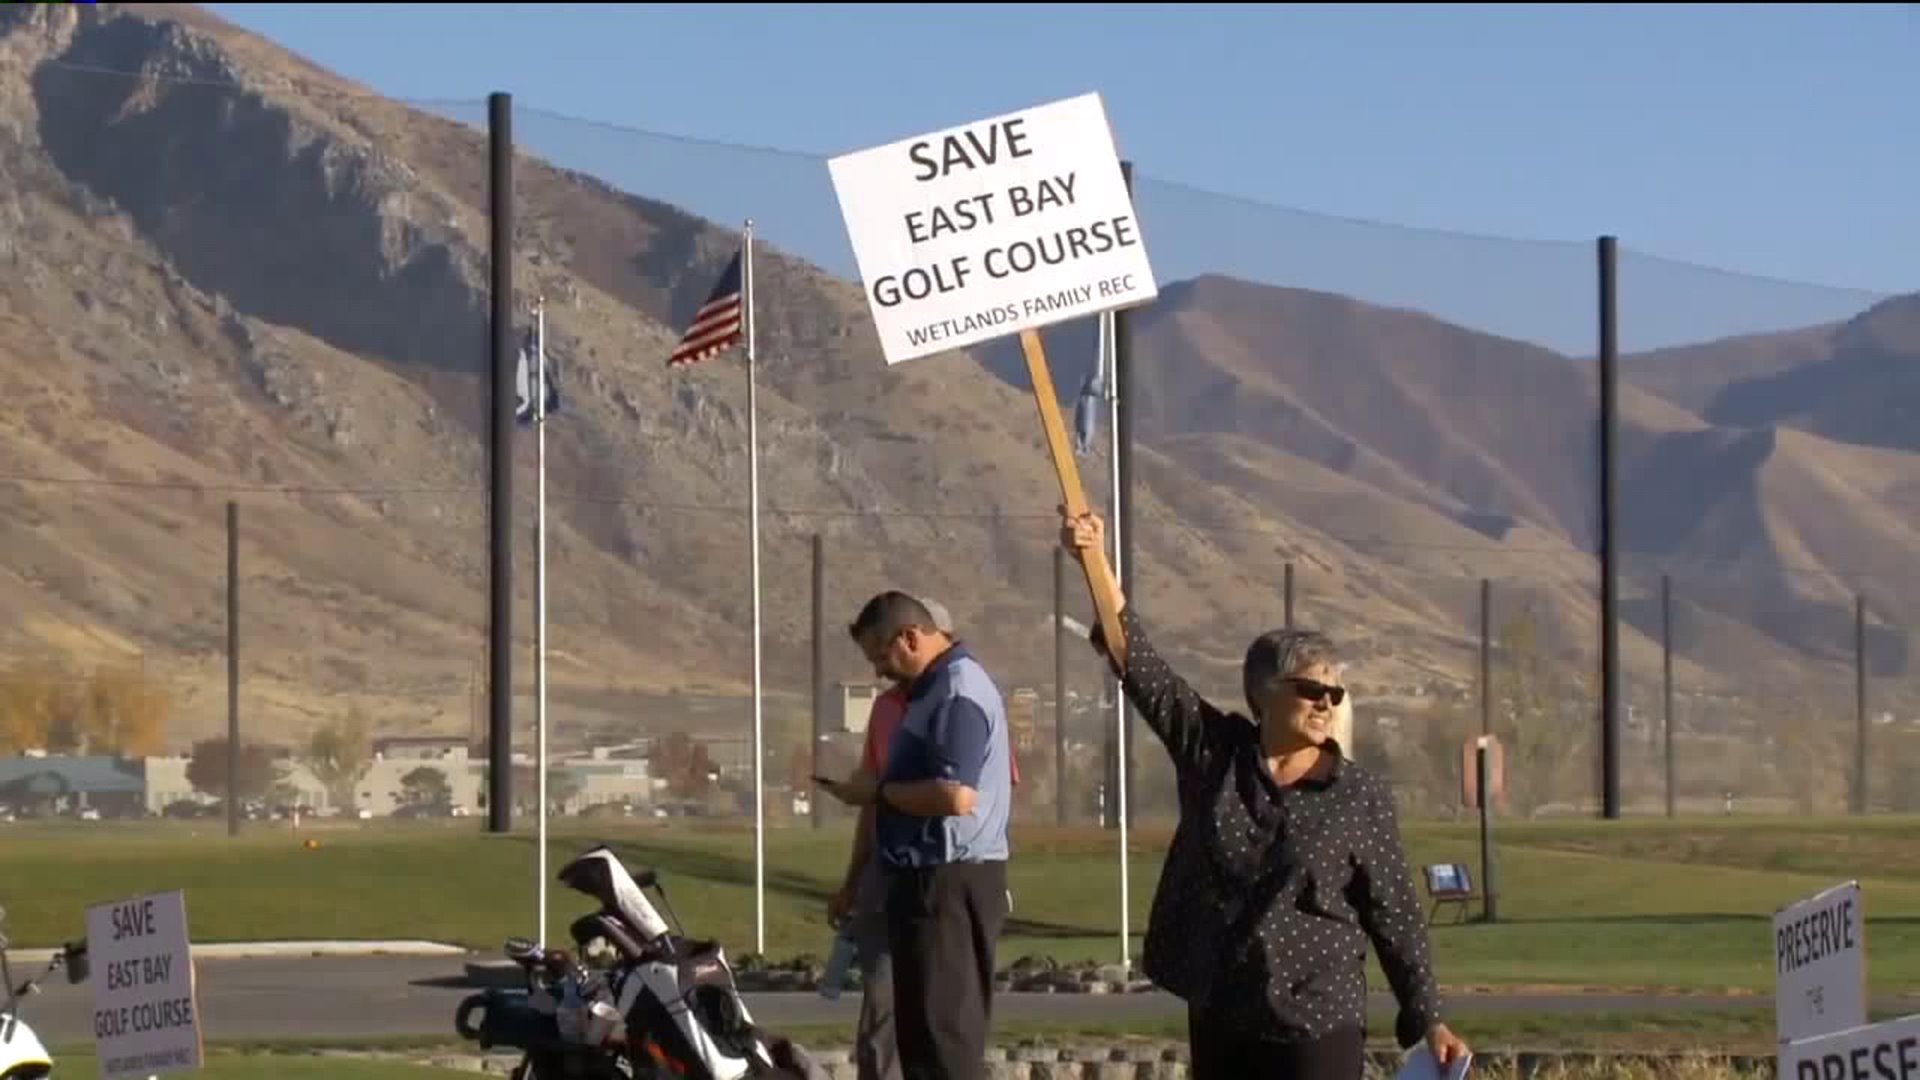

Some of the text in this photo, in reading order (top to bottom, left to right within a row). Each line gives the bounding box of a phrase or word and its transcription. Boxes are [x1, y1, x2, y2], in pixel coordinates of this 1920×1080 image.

[909, 118, 1033, 182] SAVE
[904, 172, 1078, 245] EAST BAY
[872, 216, 1137, 308] GOLF COURSE
[906, 273, 1137, 348] WETLANDS FAMILY REC
[111, 901, 156, 941] SAVE
[1776, 898, 1854, 975] PRESERVE
[107, 953, 173, 990] EAST BAY
[95, 998, 193, 1039] GOLF COURSE
